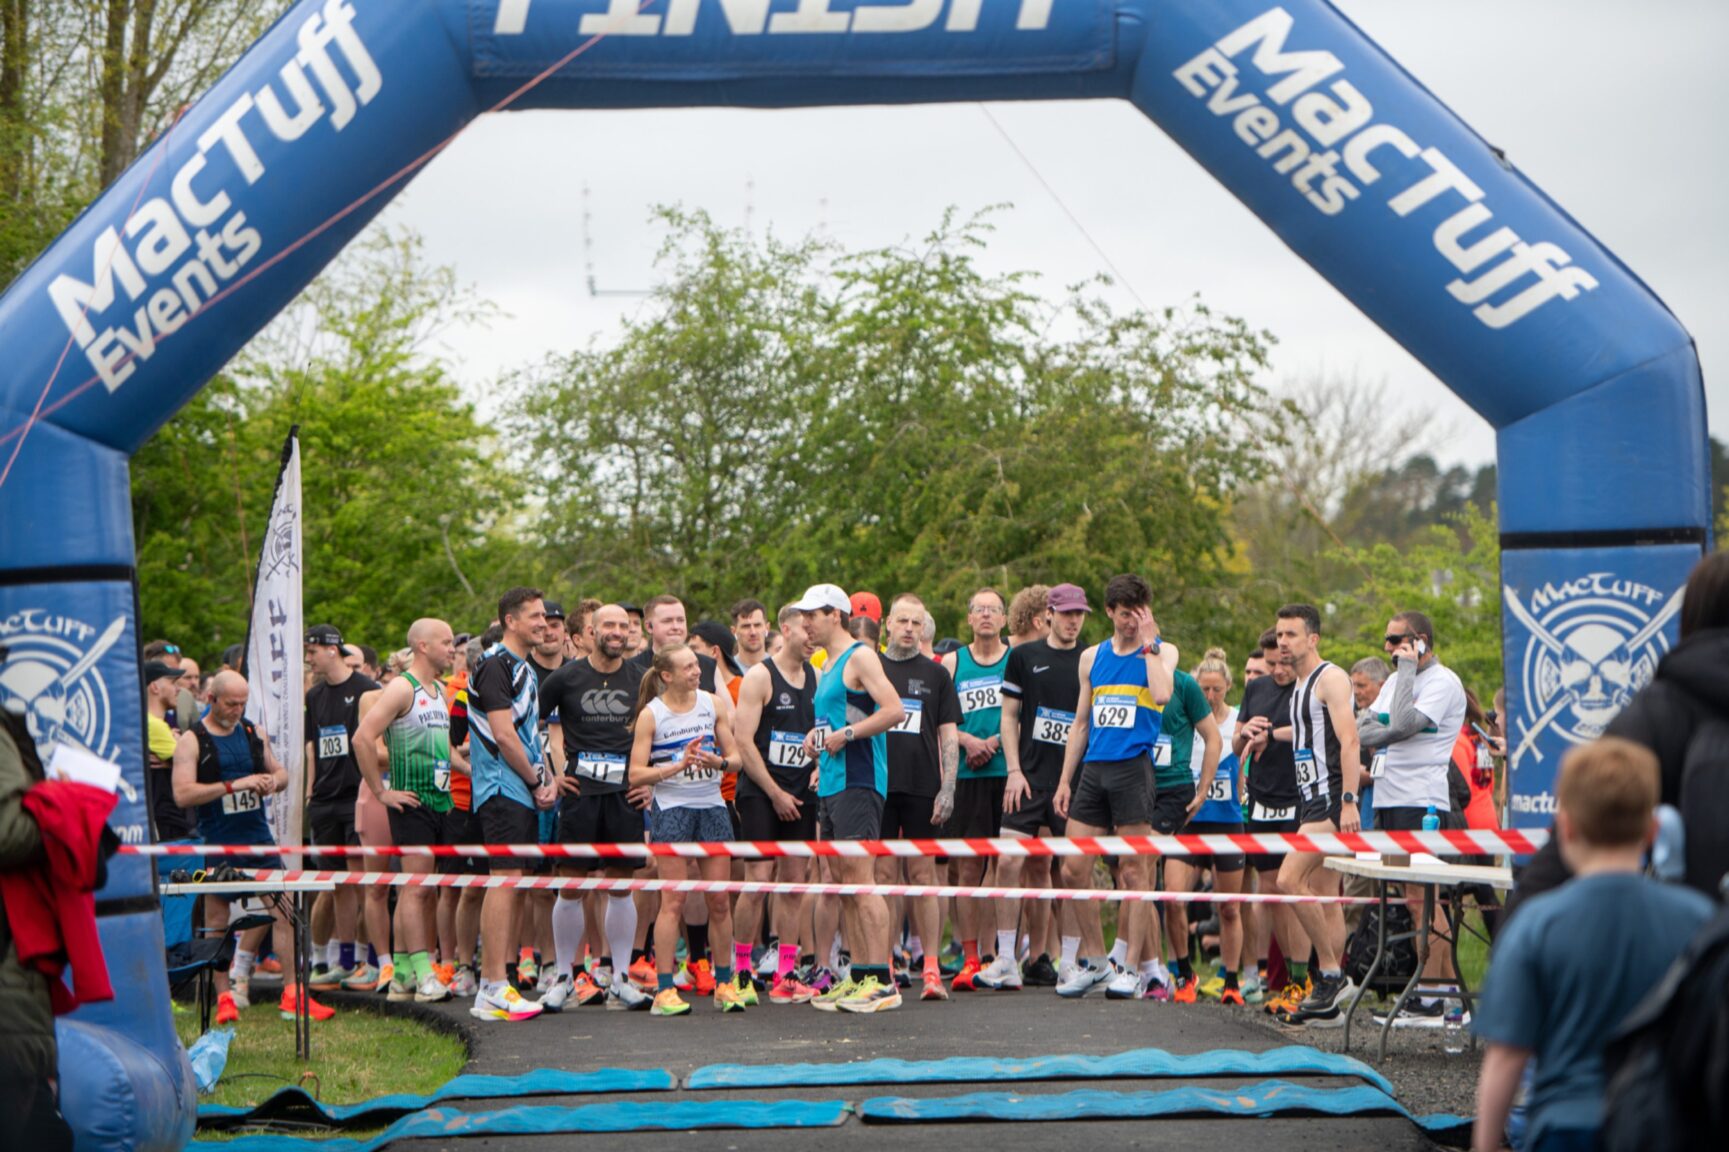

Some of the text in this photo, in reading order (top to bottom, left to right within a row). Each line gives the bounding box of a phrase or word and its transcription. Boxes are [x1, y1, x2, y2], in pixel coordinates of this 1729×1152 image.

[1172, 47, 1362, 216] Events
[1214, 7, 1600, 329] MacTuff
[85, 210, 262, 394] Events
[966, 687, 998, 710] 598
[1098, 706, 1129, 727] 629
[663, 724, 703, 740] Edinburgh
[322, 736, 342, 756] 203
[779, 744, 806, 766] 129
[232, 791, 256, 811] 145
